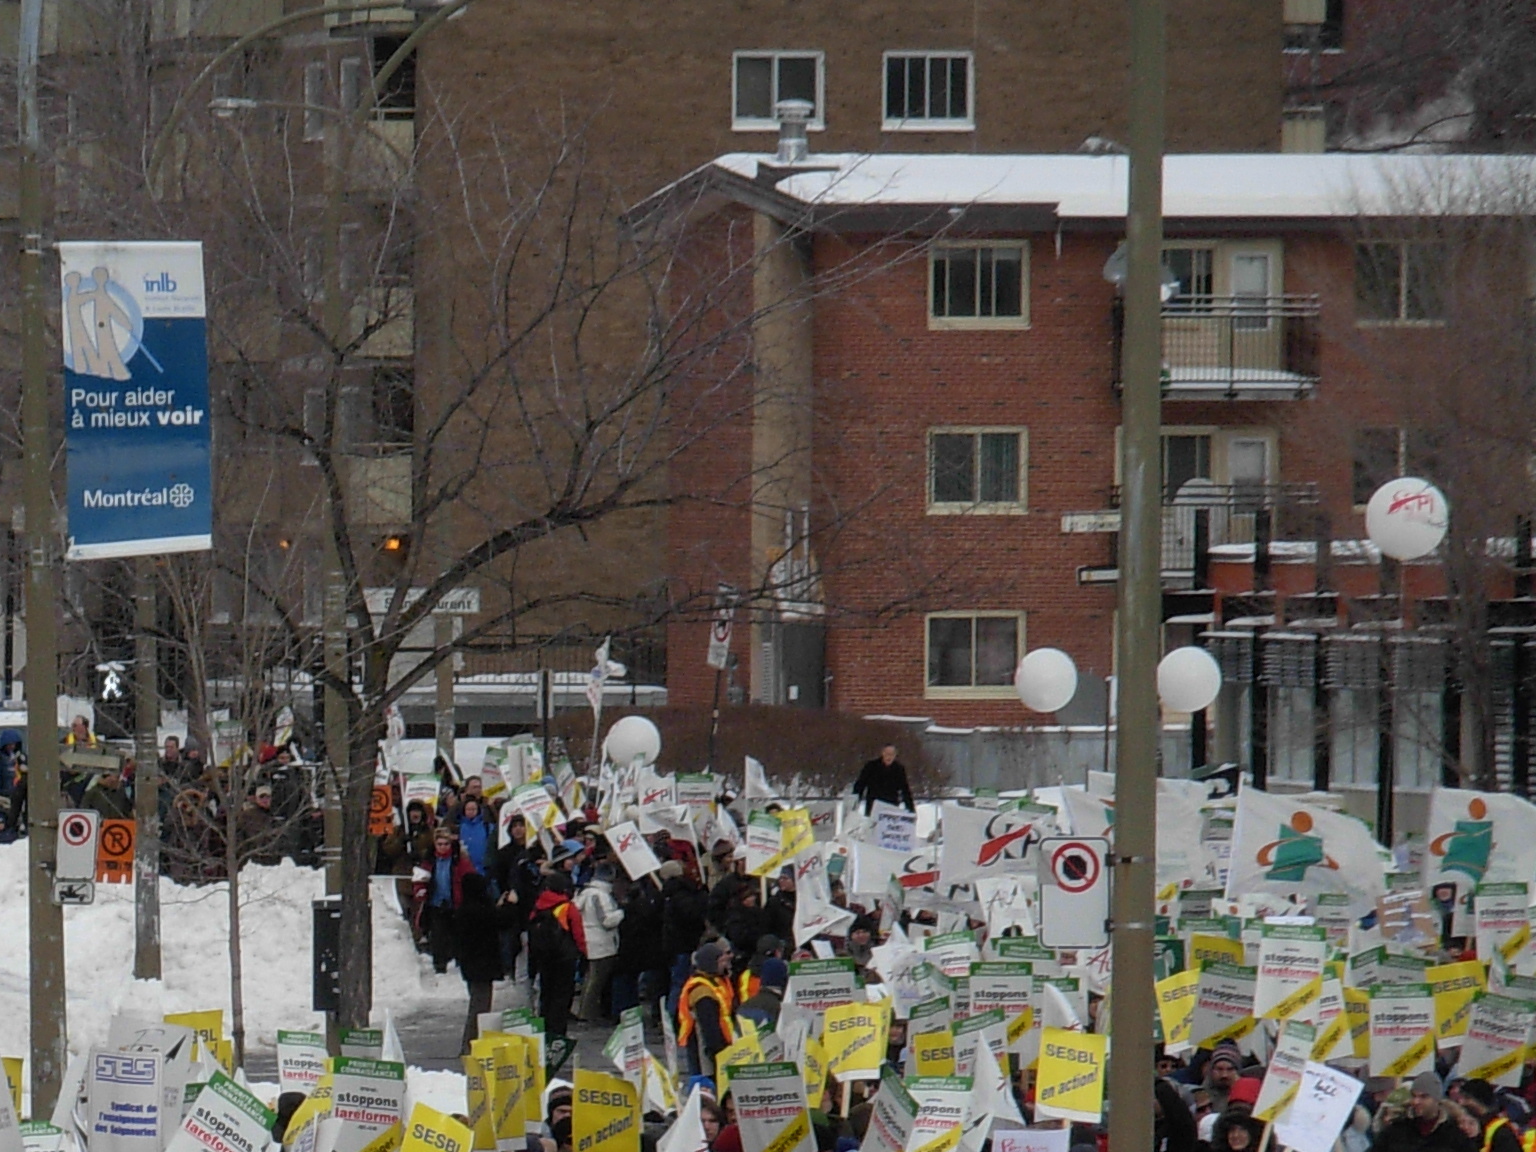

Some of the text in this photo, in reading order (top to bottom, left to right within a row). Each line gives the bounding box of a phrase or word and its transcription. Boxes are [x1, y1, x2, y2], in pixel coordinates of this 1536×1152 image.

[71, 386, 175, 407] Pour aider
[71, 405, 204, 428] à mieux voir
[84, 487, 168, 508] Montréal
[1265, 954, 1319, 965] stoppons
[796, 987, 852, 998] stoppons
[974, 990, 1028, 1000] stoppons
[829, 1016, 875, 1033] SESBL
[1374, 1012, 1429, 1023] stoppons
[841, 1028, 875, 1061] action!
[1045, 1044, 1098, 1065] SESBL
[96, 1055, 156, 1082] SES
[283, 1058, 324, 1069] stoppo
[282, 1070, 321, 1081] larefor
[1041, 1067, 1098, 1100] en action!
[337, 1092, 398, 1108] stoppons
[578, 1089, 633, 1108] SESBL
[738, 1091, 799, 1103] stoppons
[111, 1102, 157, 1113] Syndicat de
[335, 1107, 399, 1122] lareforme
[918, 1105, 961, 1114] oppons
[95, 1124, 107, 1133] des
[196, 1107, 254, 1152] stoppons
[578, 1111, 633, 1151] en action!
